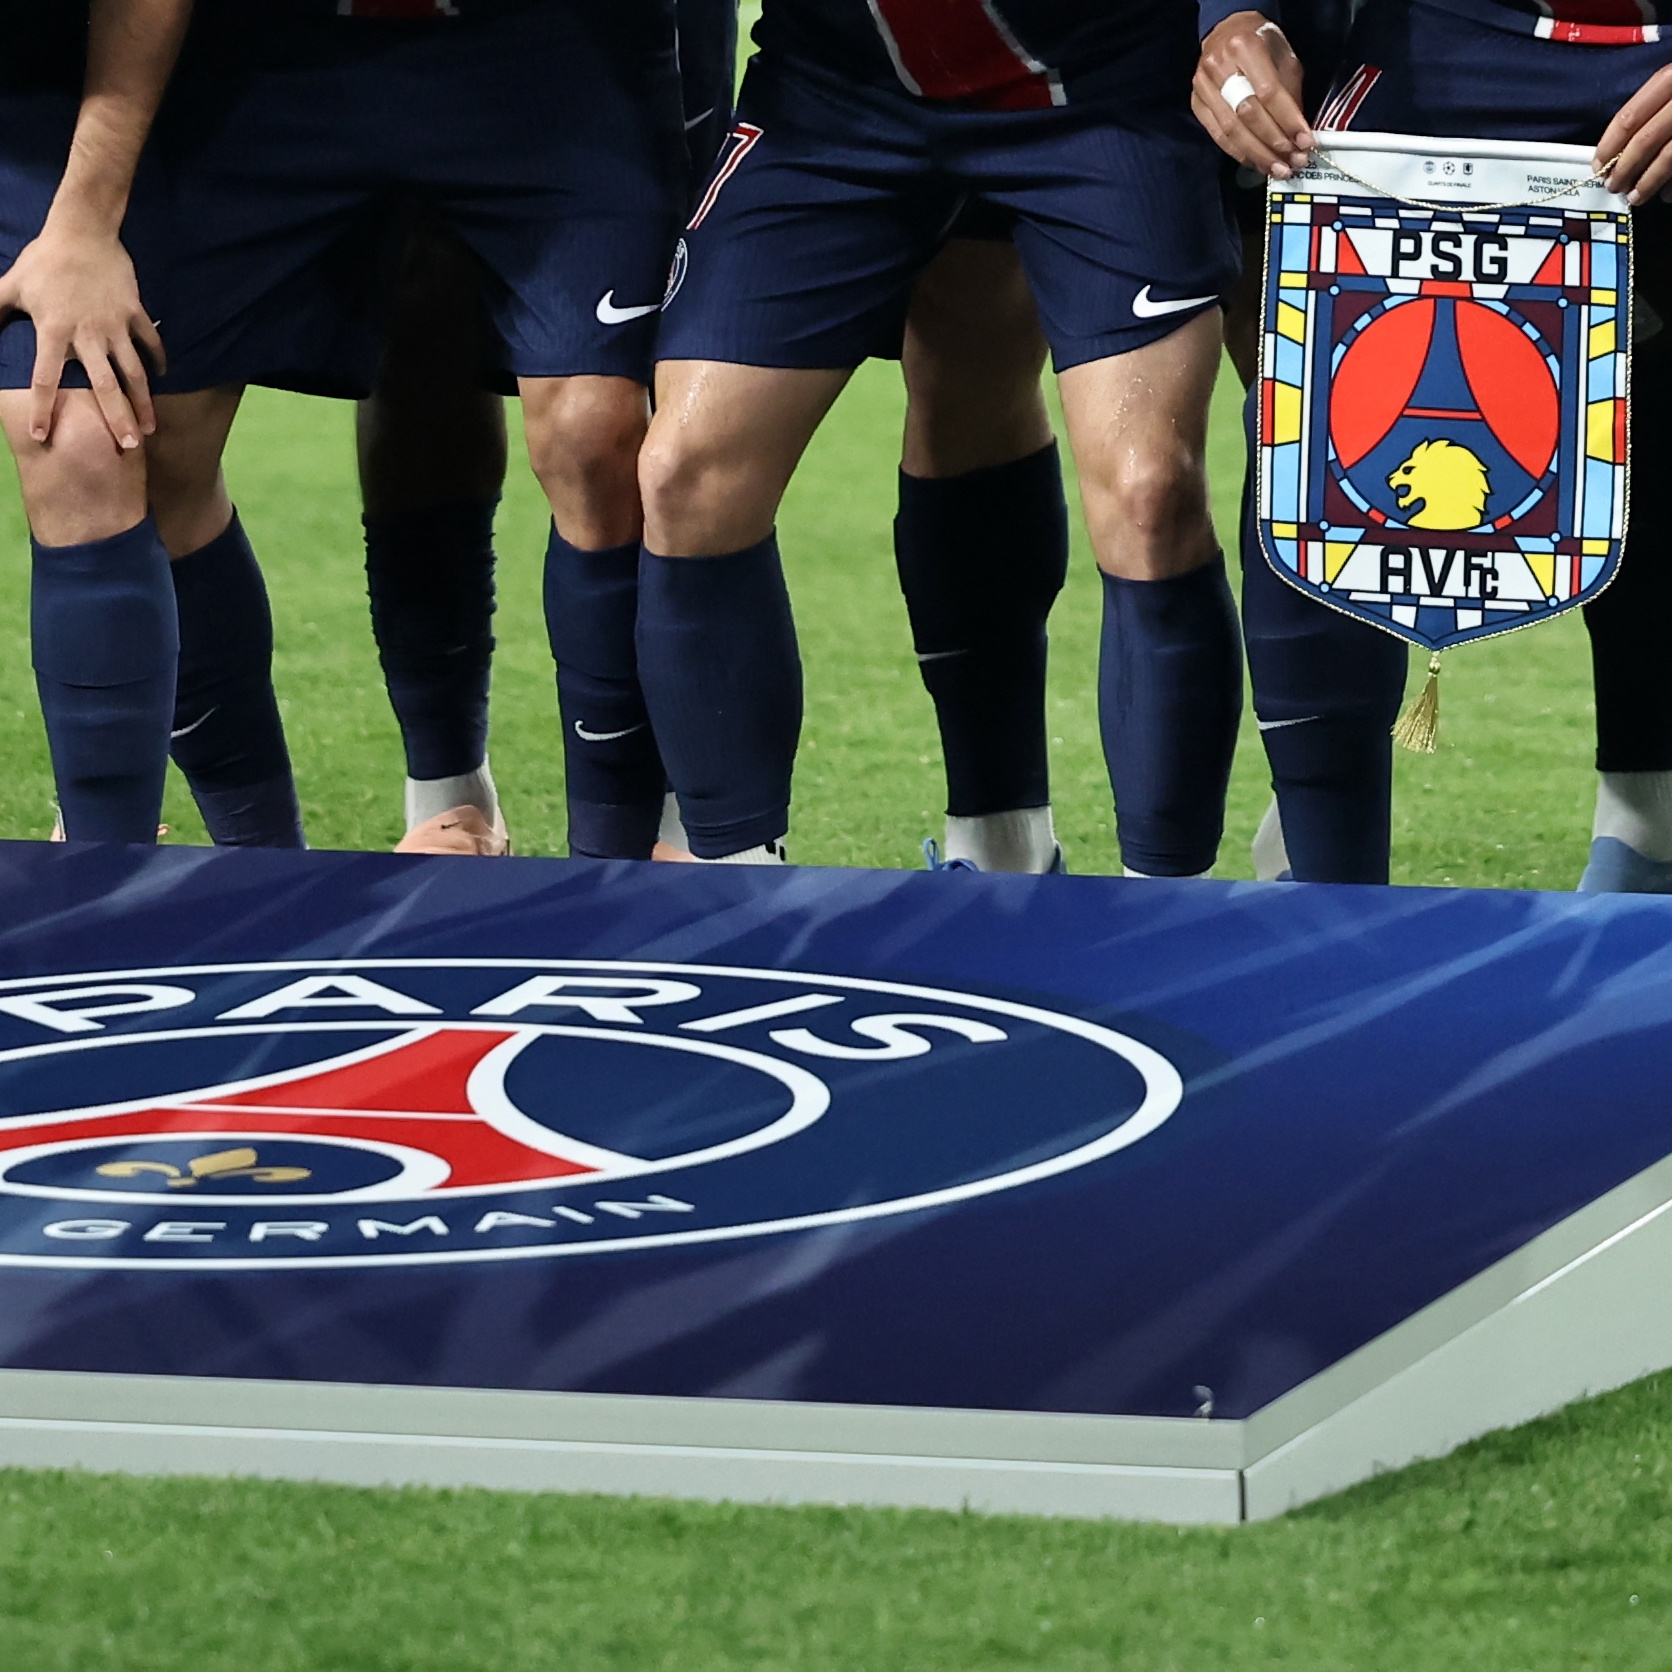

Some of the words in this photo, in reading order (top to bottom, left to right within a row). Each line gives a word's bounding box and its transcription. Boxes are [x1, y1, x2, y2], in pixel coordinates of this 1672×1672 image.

[1527, 175, 1552, 185] PARIS
[1528, 185, 1557, 195] ASTON
[1390, 230, 1509, 283] PSG
[42, 1193, 694, 1243] GERMAIN
